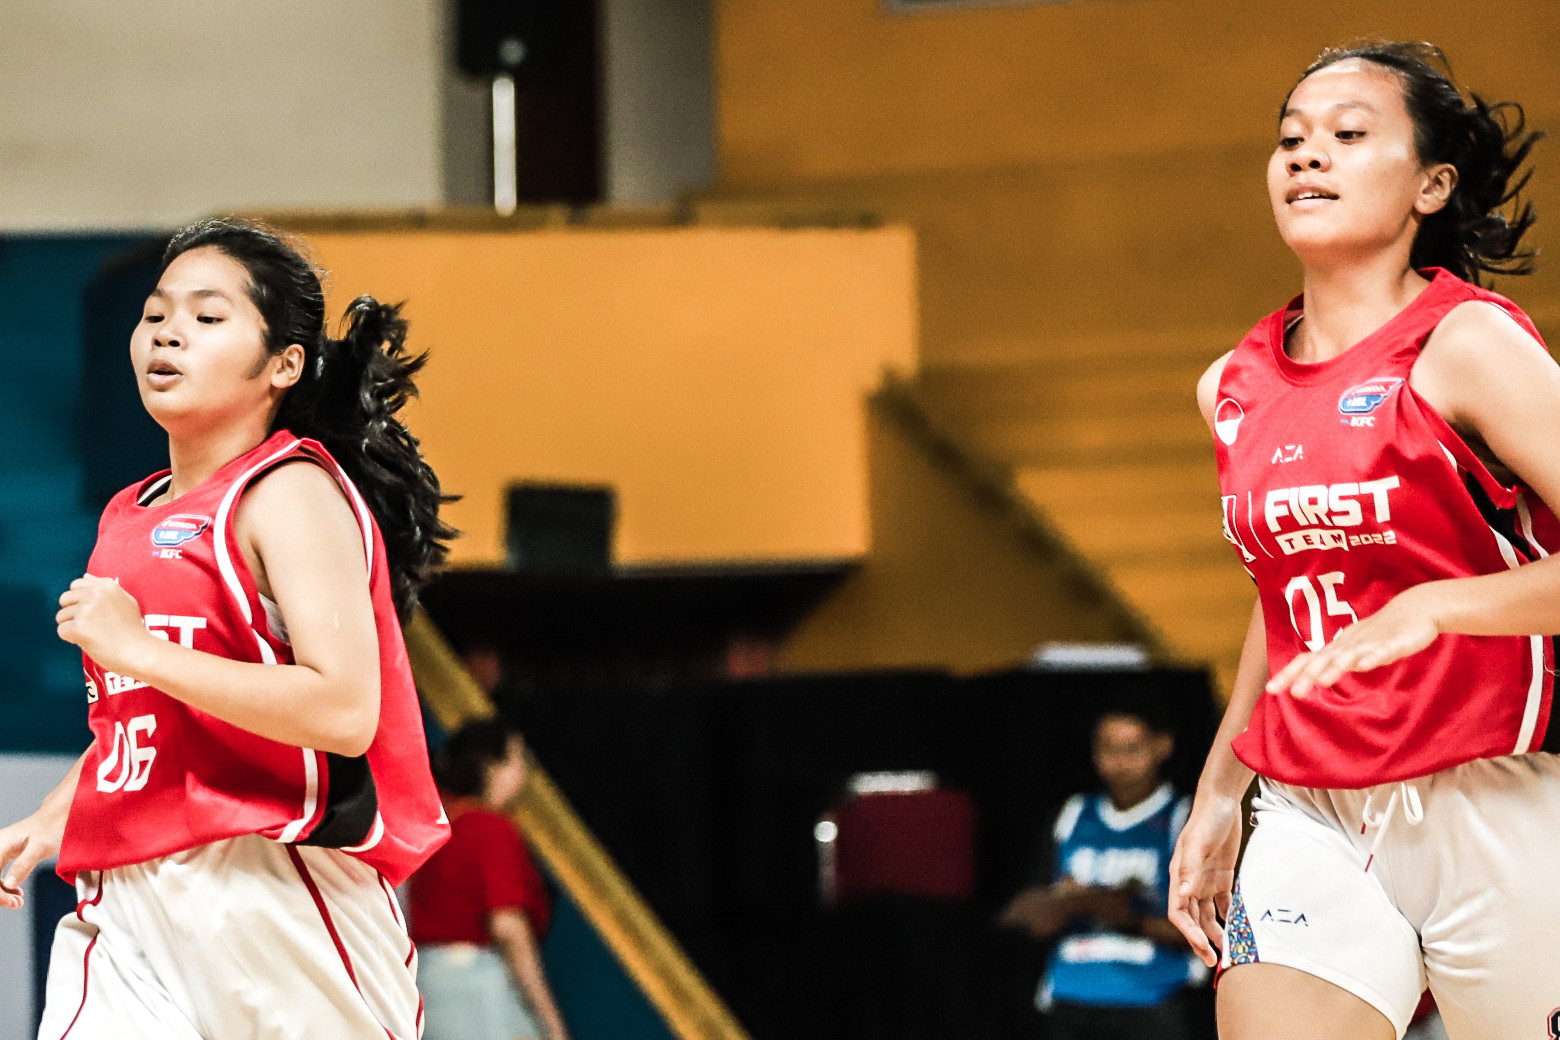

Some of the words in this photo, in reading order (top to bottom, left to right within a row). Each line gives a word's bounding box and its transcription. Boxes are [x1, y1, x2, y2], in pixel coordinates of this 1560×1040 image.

[1350, 416, 1375, 427] KFC
[1264, 475, 1400, 533] FIRST
[1281, 530, 1347, 552] TEAM
[1350, 530, 1397, 547] 2022
[160, 548, 183, 559] KFC
[96, 714, 158, 793] 06
